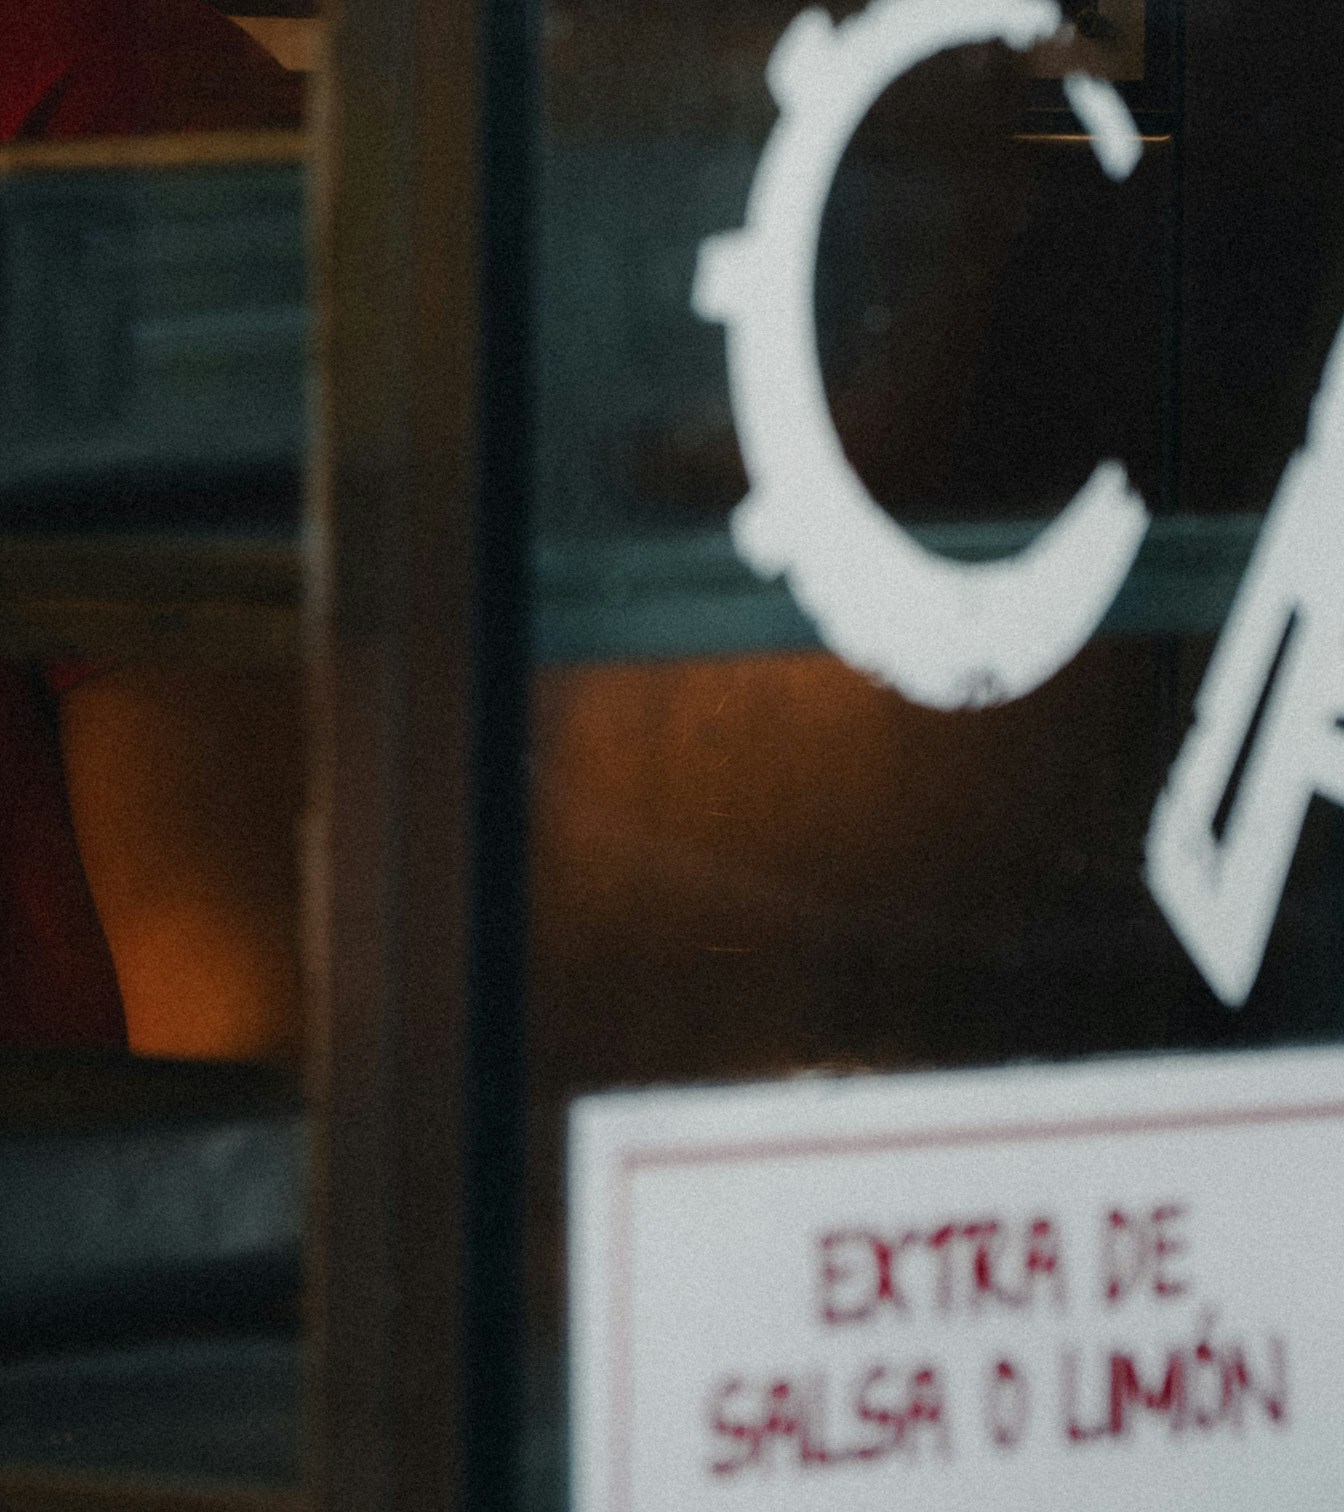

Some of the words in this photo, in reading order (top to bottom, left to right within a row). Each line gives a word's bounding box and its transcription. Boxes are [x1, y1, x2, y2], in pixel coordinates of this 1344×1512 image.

[818, 1214, 1066, 1327] EXTRA
[1104, 1198, 1193, 1305] DE
[709, 1364, 950, 1479] SALSA
[1064, 1301, 1290, 1448] LIMÓN
